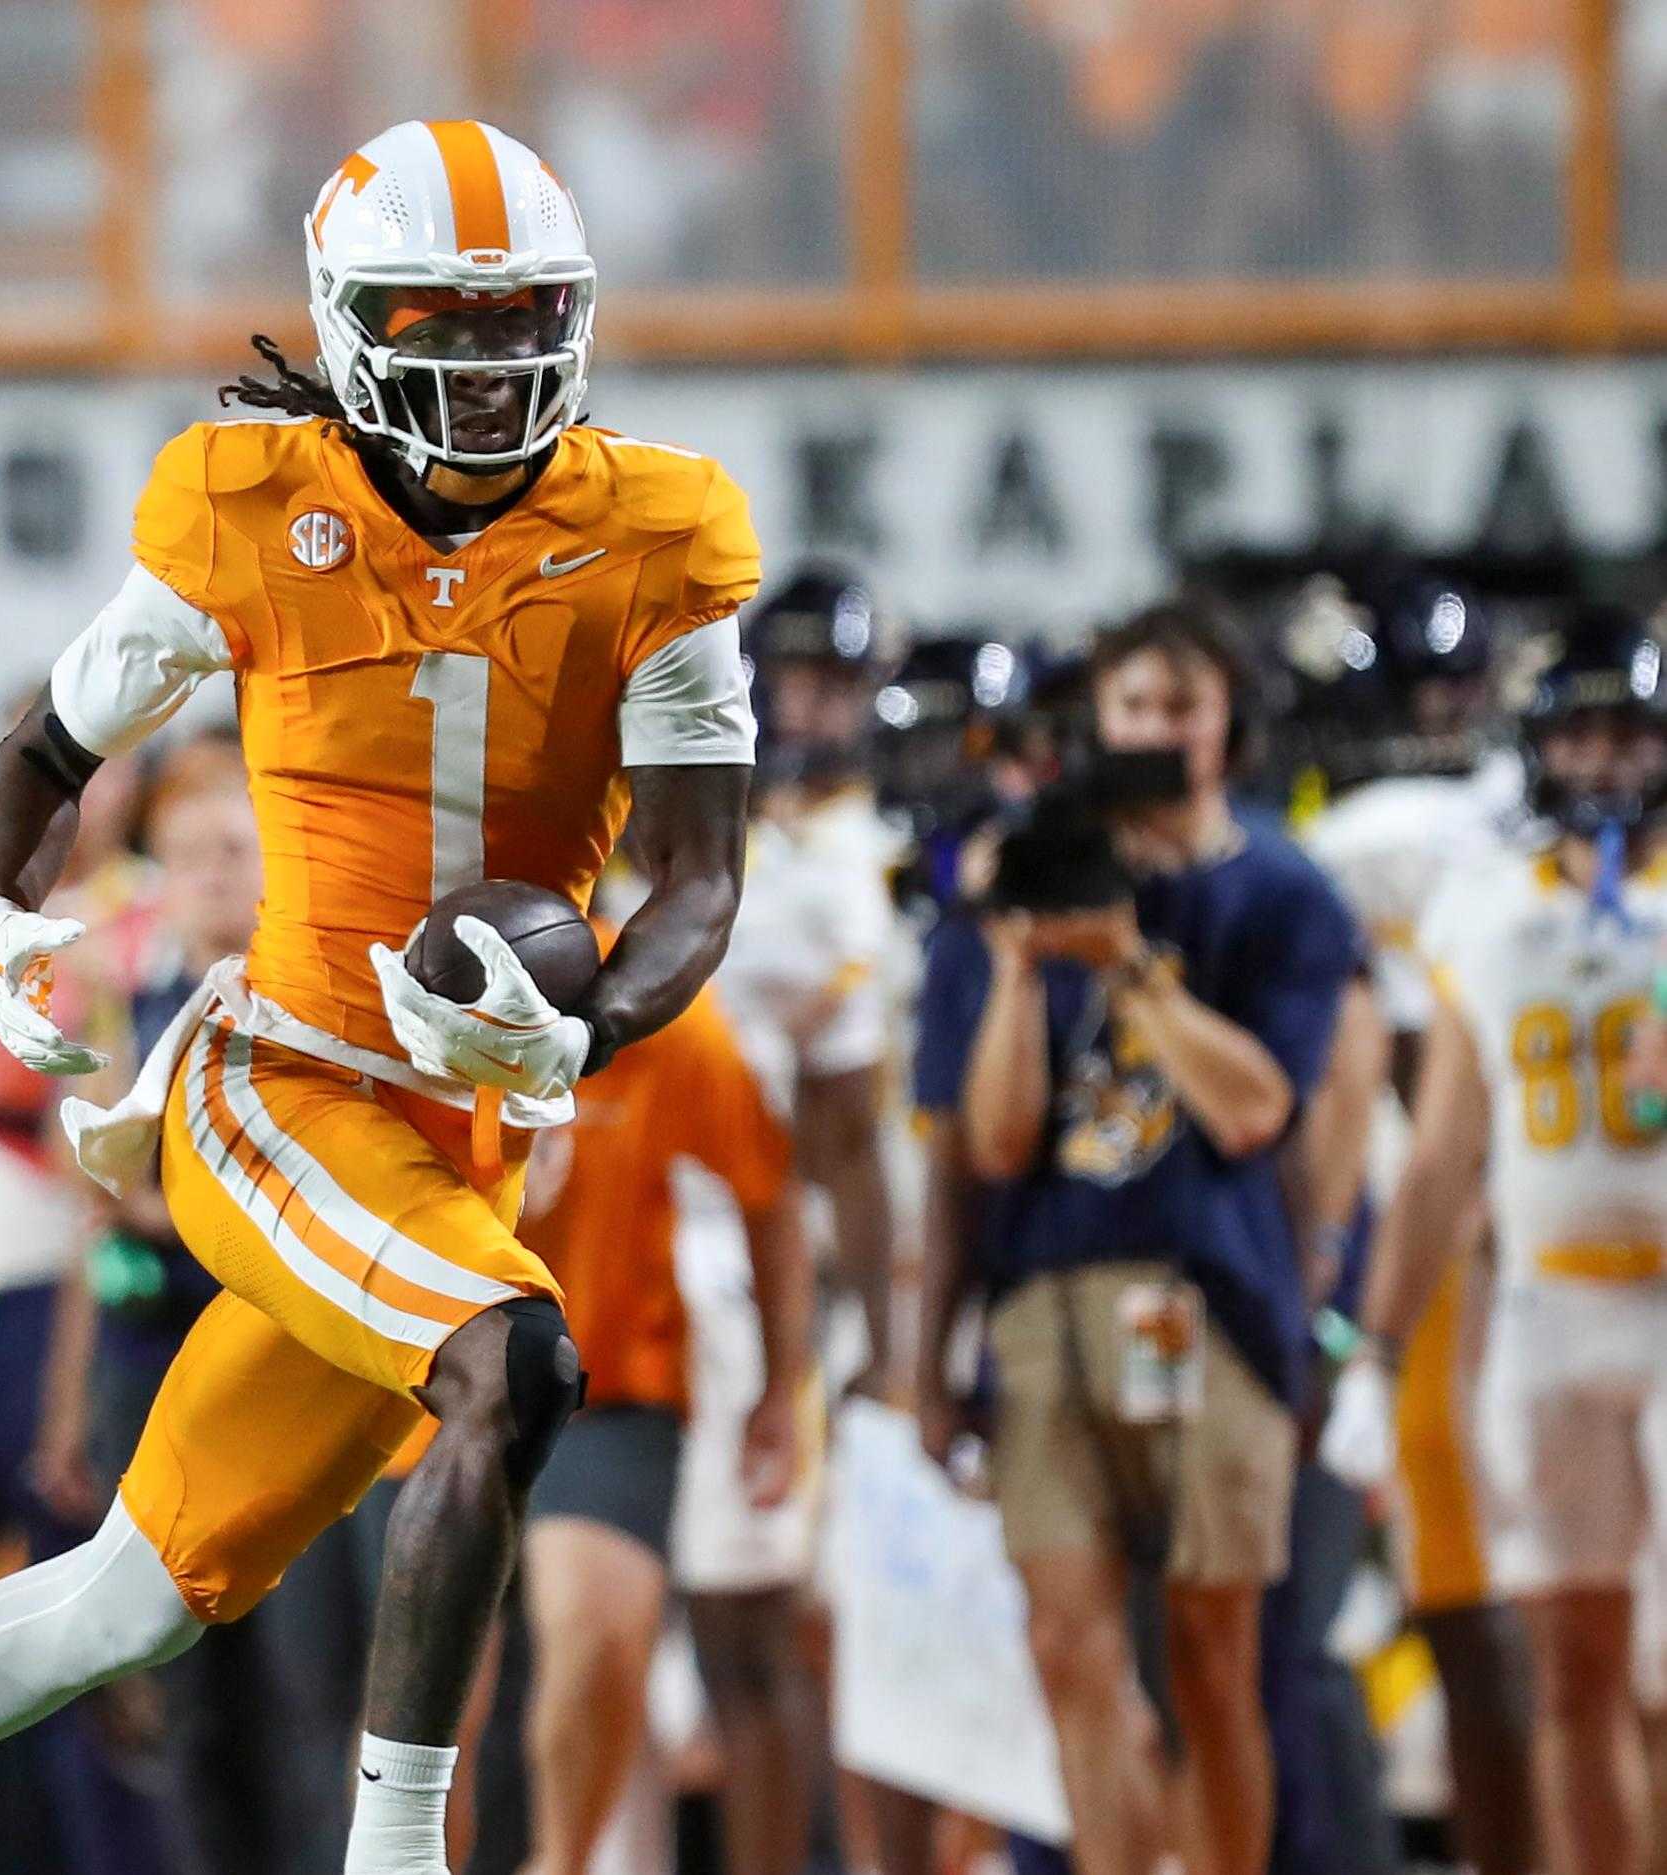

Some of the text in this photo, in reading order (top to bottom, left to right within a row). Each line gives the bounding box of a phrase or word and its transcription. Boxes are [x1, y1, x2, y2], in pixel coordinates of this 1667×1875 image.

[290, 511, 350, 568] SEC
[788, 420, 1667, 562] KAPLA
[425, 567, 466, 607] T
[410, 652, 491, 906] 1
